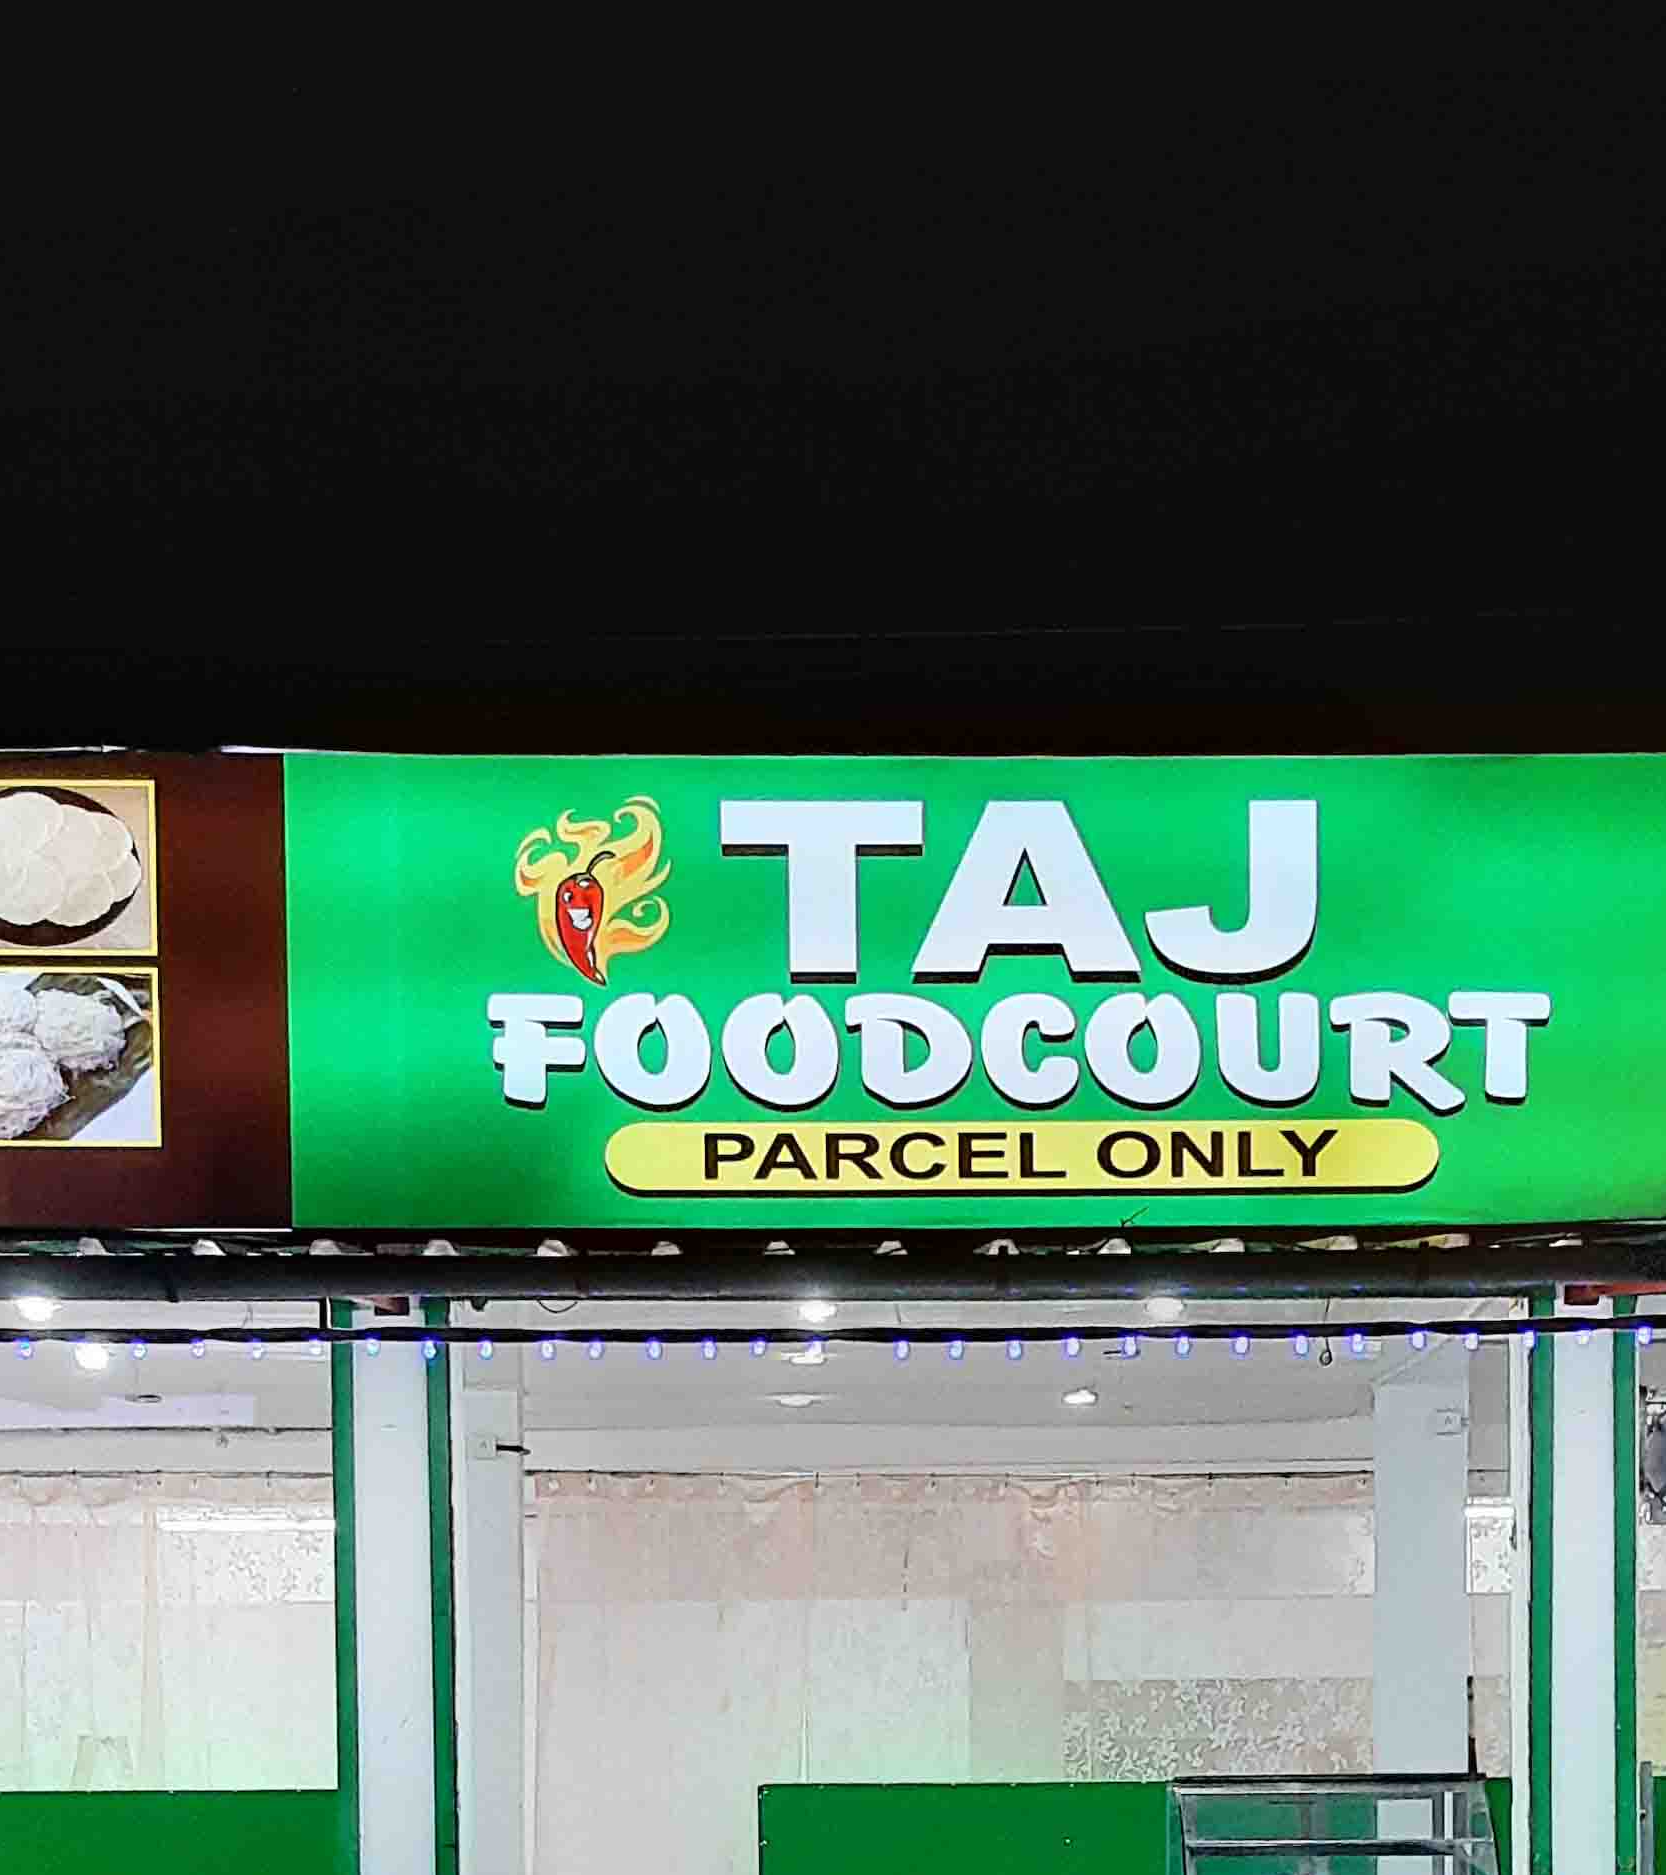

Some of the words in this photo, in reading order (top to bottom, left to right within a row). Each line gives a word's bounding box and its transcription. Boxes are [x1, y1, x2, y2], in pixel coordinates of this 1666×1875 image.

[720, 799, 1320, 984] TAJ
[486, 991, 1552, 1116] FOODCOURT
[702, 1131, 1067, 1181] PARCEL
[1096, 1129, 1339, 1179] ONLY
